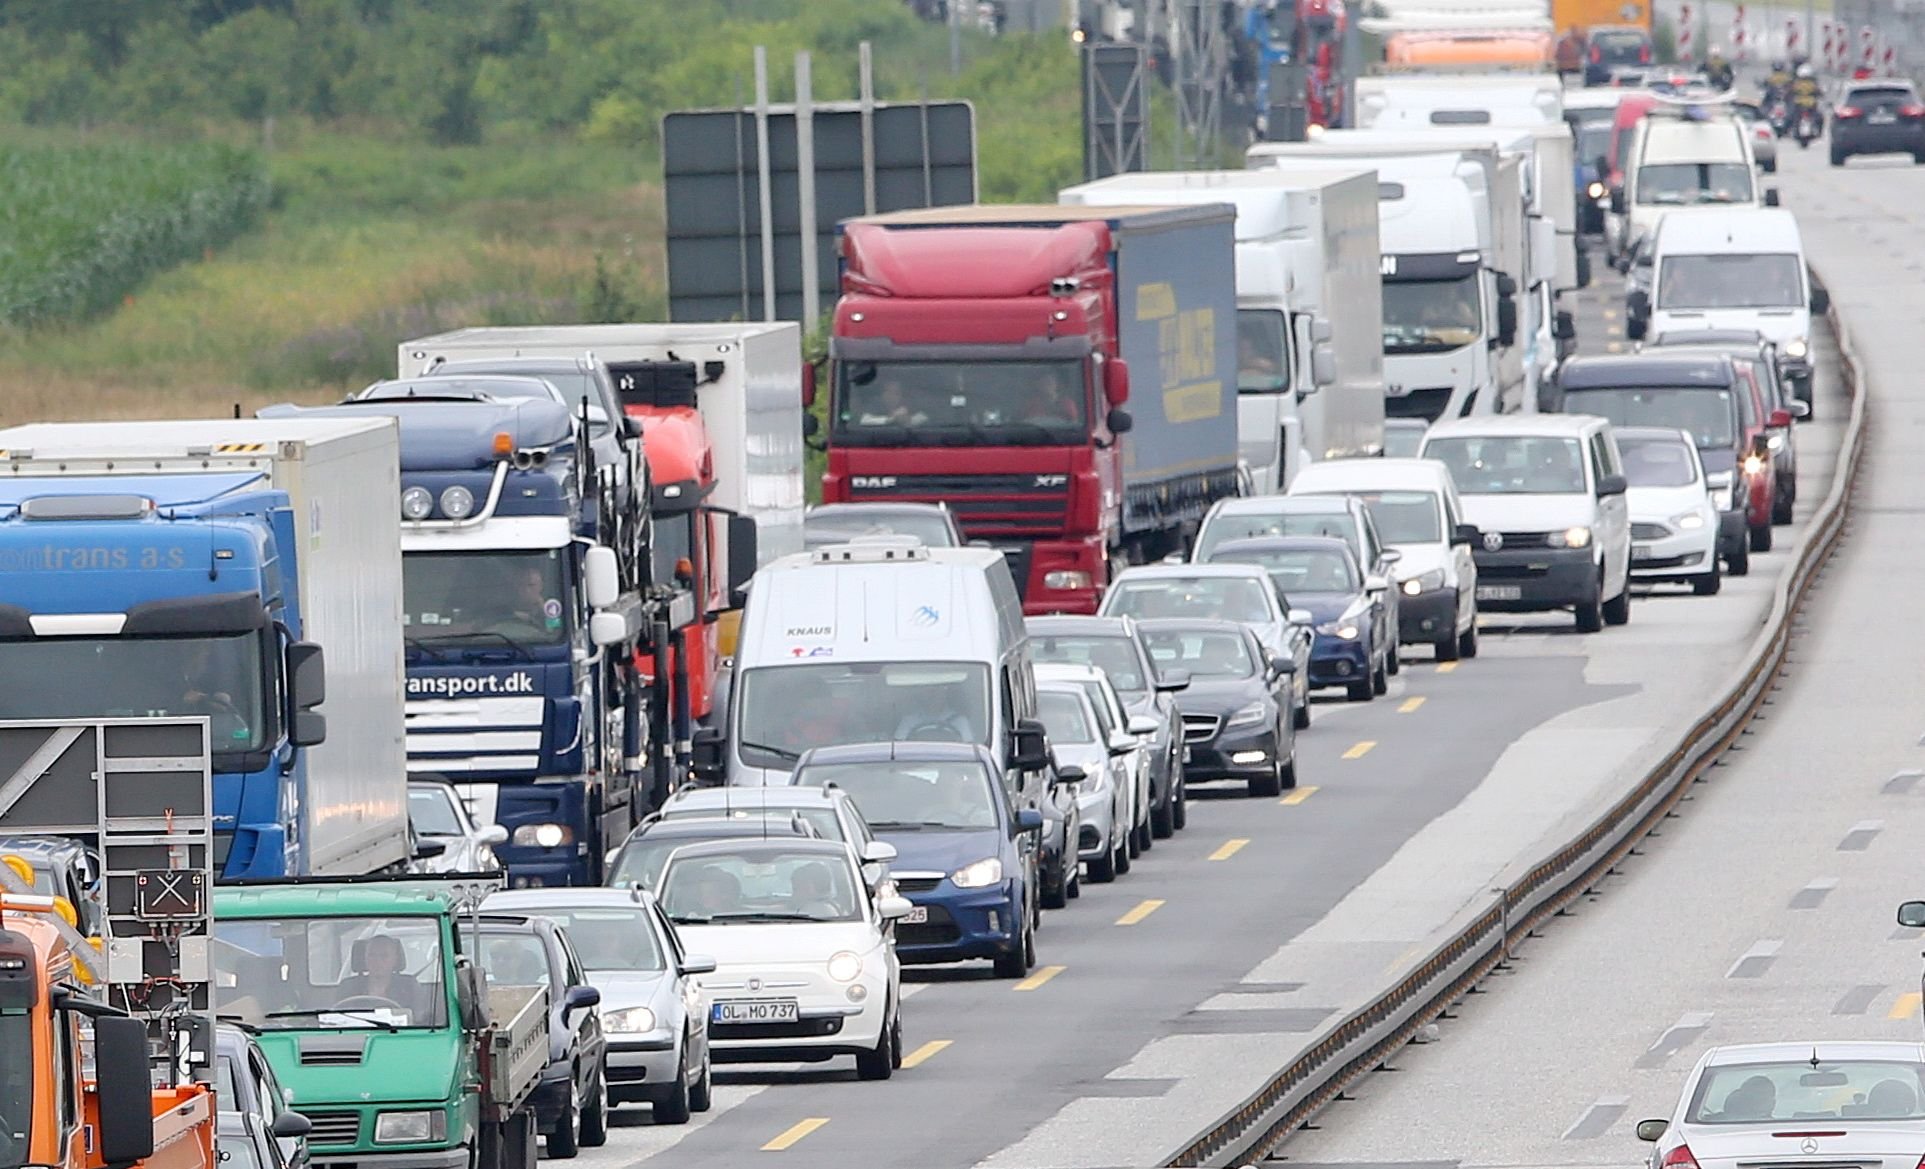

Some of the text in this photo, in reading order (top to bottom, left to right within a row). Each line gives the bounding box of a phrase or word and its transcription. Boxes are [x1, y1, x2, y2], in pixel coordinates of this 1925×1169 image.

[852, 477, 897, 488] DAF
[1034, 475, 1067, 487] XF
[786, 626, 832, 636] KNAUS
[404, 672, 534, 697] ansport.dk
[770, 1004, 795, 1018] 737
